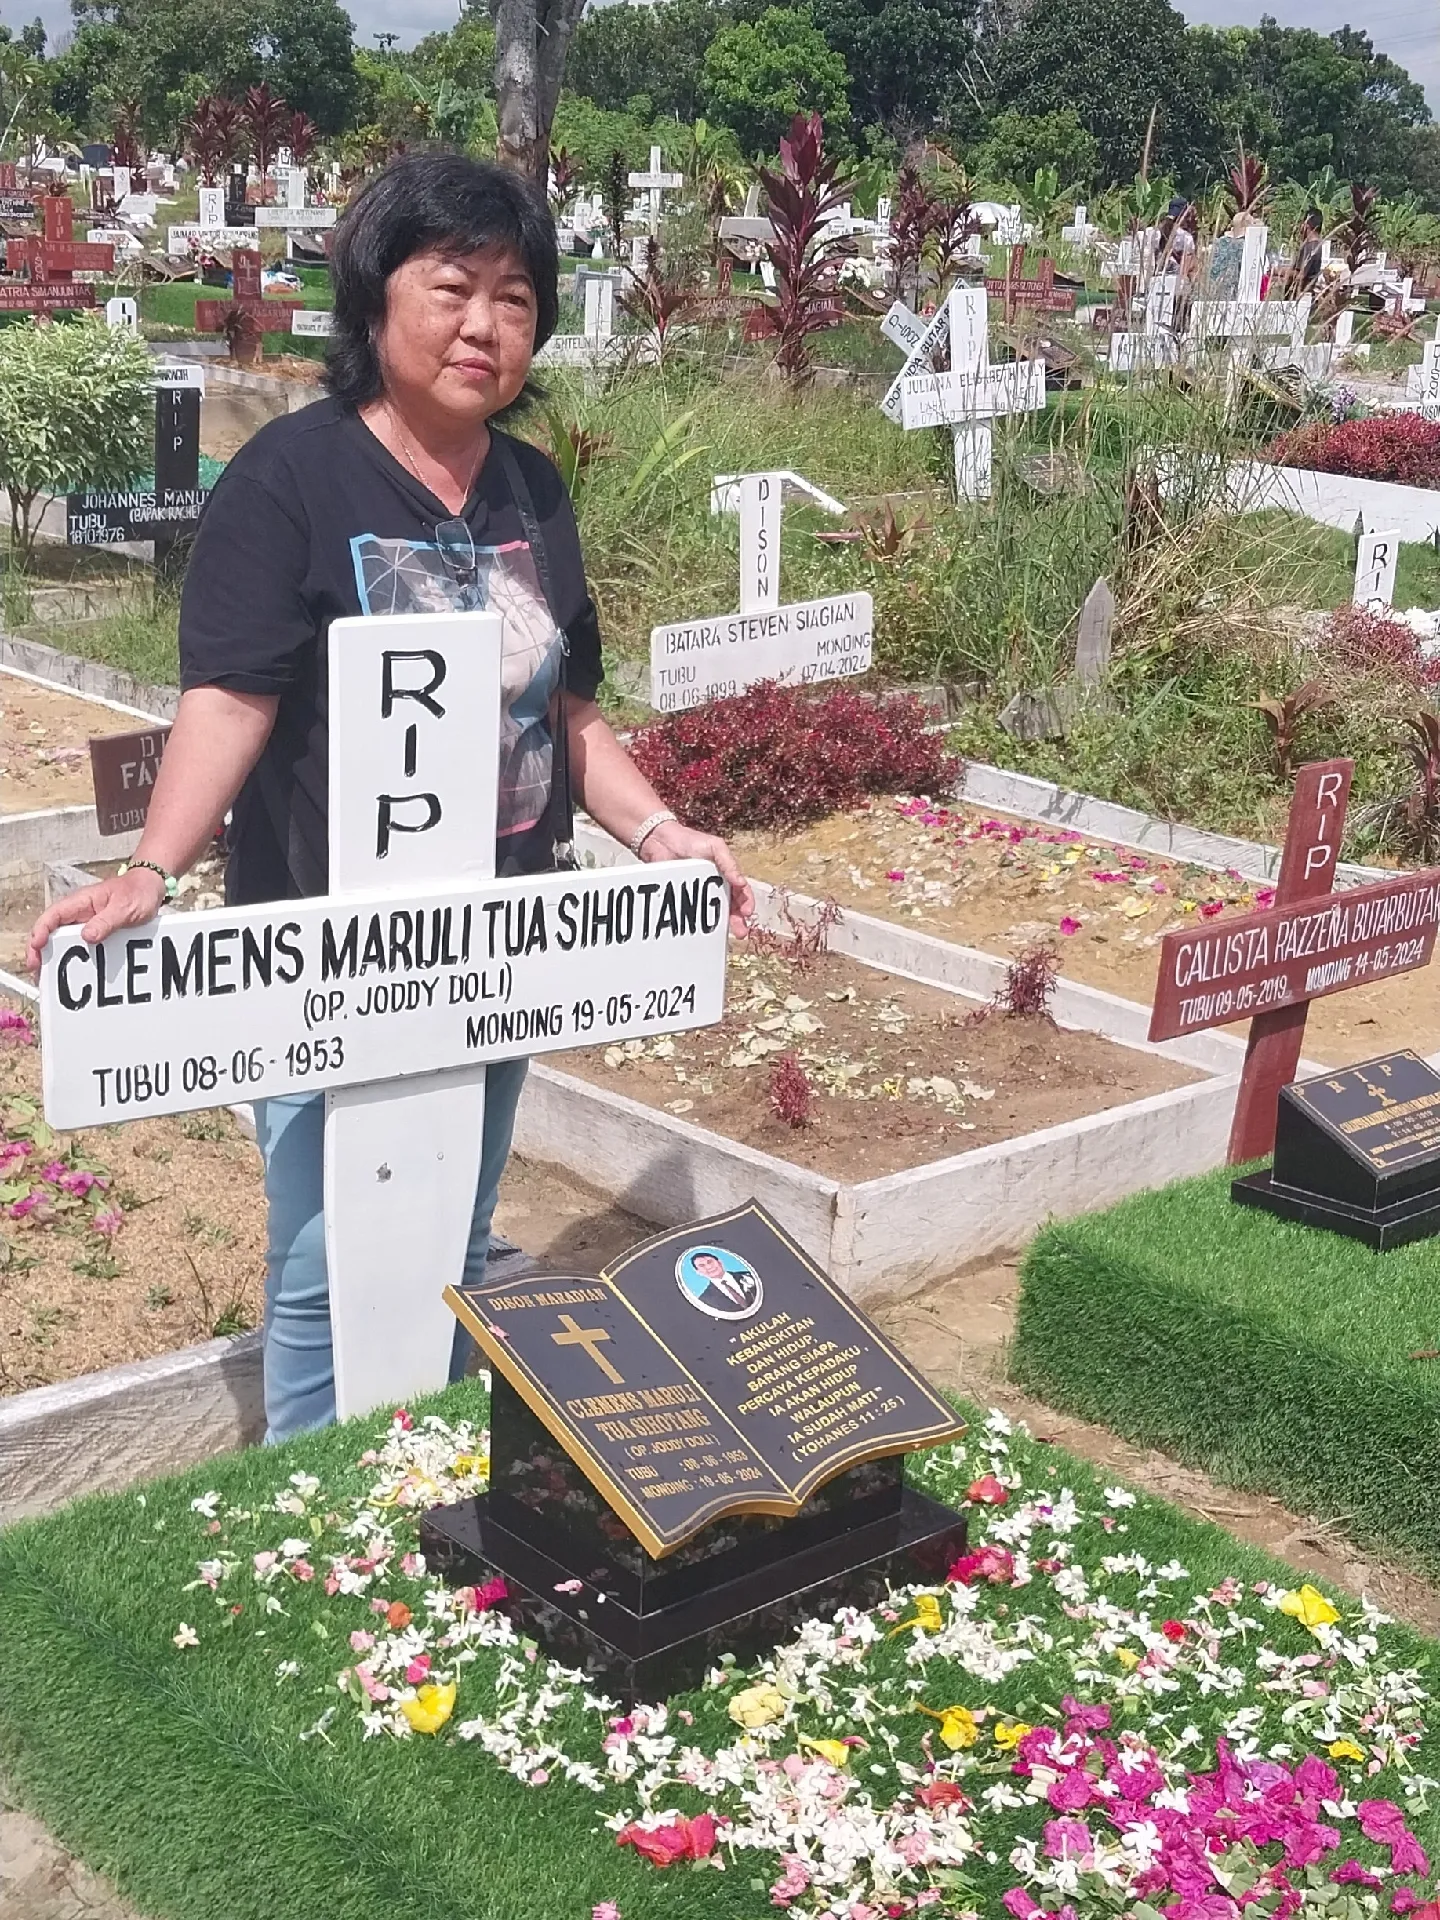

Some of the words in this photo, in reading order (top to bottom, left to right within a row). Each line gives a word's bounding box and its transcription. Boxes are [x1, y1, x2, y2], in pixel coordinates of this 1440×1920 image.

[208, 194, 219, 226] RIP
[965, 295, 976, 361] RIP
[172, 390, 183, 451] RIP
[69, 513, 107, 530] TUBU
[82, 493, 156, 509] JOHANNES
[757, 478, 770, 598] DISON
[666, 624, 722, 655] BATARA
[728, 613, 789, 643] STEVEN
[796, 602, 855, 631] SIAGIAN
[817, 632, 871, 657] MONDING
[659, 666, 696, 687] TUBU
[375, 649, 447, 860] RIP
[1304, 773, 1342, 880] RIP
[57, 923, 304, 1012] CLEMENS
[320, 907, 470, 982] MARULI
[480, 899, 547, 961] TUA
[555, 875, 723, 949] SIHOTANG
[1175, 927, 1268, 988] CALLISTA
[356, 976, 440, 1019] JODDY
[448, 962, 514, 1006] DOLI)
[1180, 994, 1217, 1027] TUBU
[1305, 957, 1353, 993] MONDING
[93, 1062, 170, 1108] TUBU
[466, 1006, 563, 1049] MONDING
[571, 984, 696, 1033] 19-05-2024
[726, 1317, 816, 1367] KEBANGKITAN
[747, 1354, 776, 1374] DAN
[747, 1360, 801, 1392] BARANG
[800, 1341, 838, 1364] SIAPA
[566, 1392, 644, 1419] CLEMENS
[637, 1383, 701, 1409] MARULI
[737, 1381, 797, 1416] PERCAYA
[768, 1404, 787, 1417] IA
[785, 1386, 821, 1410] AKAN
[820, 1364, 857, 1390] HIDUP
[790, 1381, 862, 1424] WALAUPUN
[595, 1420, 637, 1442] TUA
[630, 1408, 712, 1437] SIHOTANG
[651, 1437, 684, 1455] JODDY
[787, 1431, 805, 1444] IA
[802, 1407, 848, 1436] SUDAH
[624, 1465, 660, 1481] TUBU
[640, 1479, 694, 1499] MONDING
